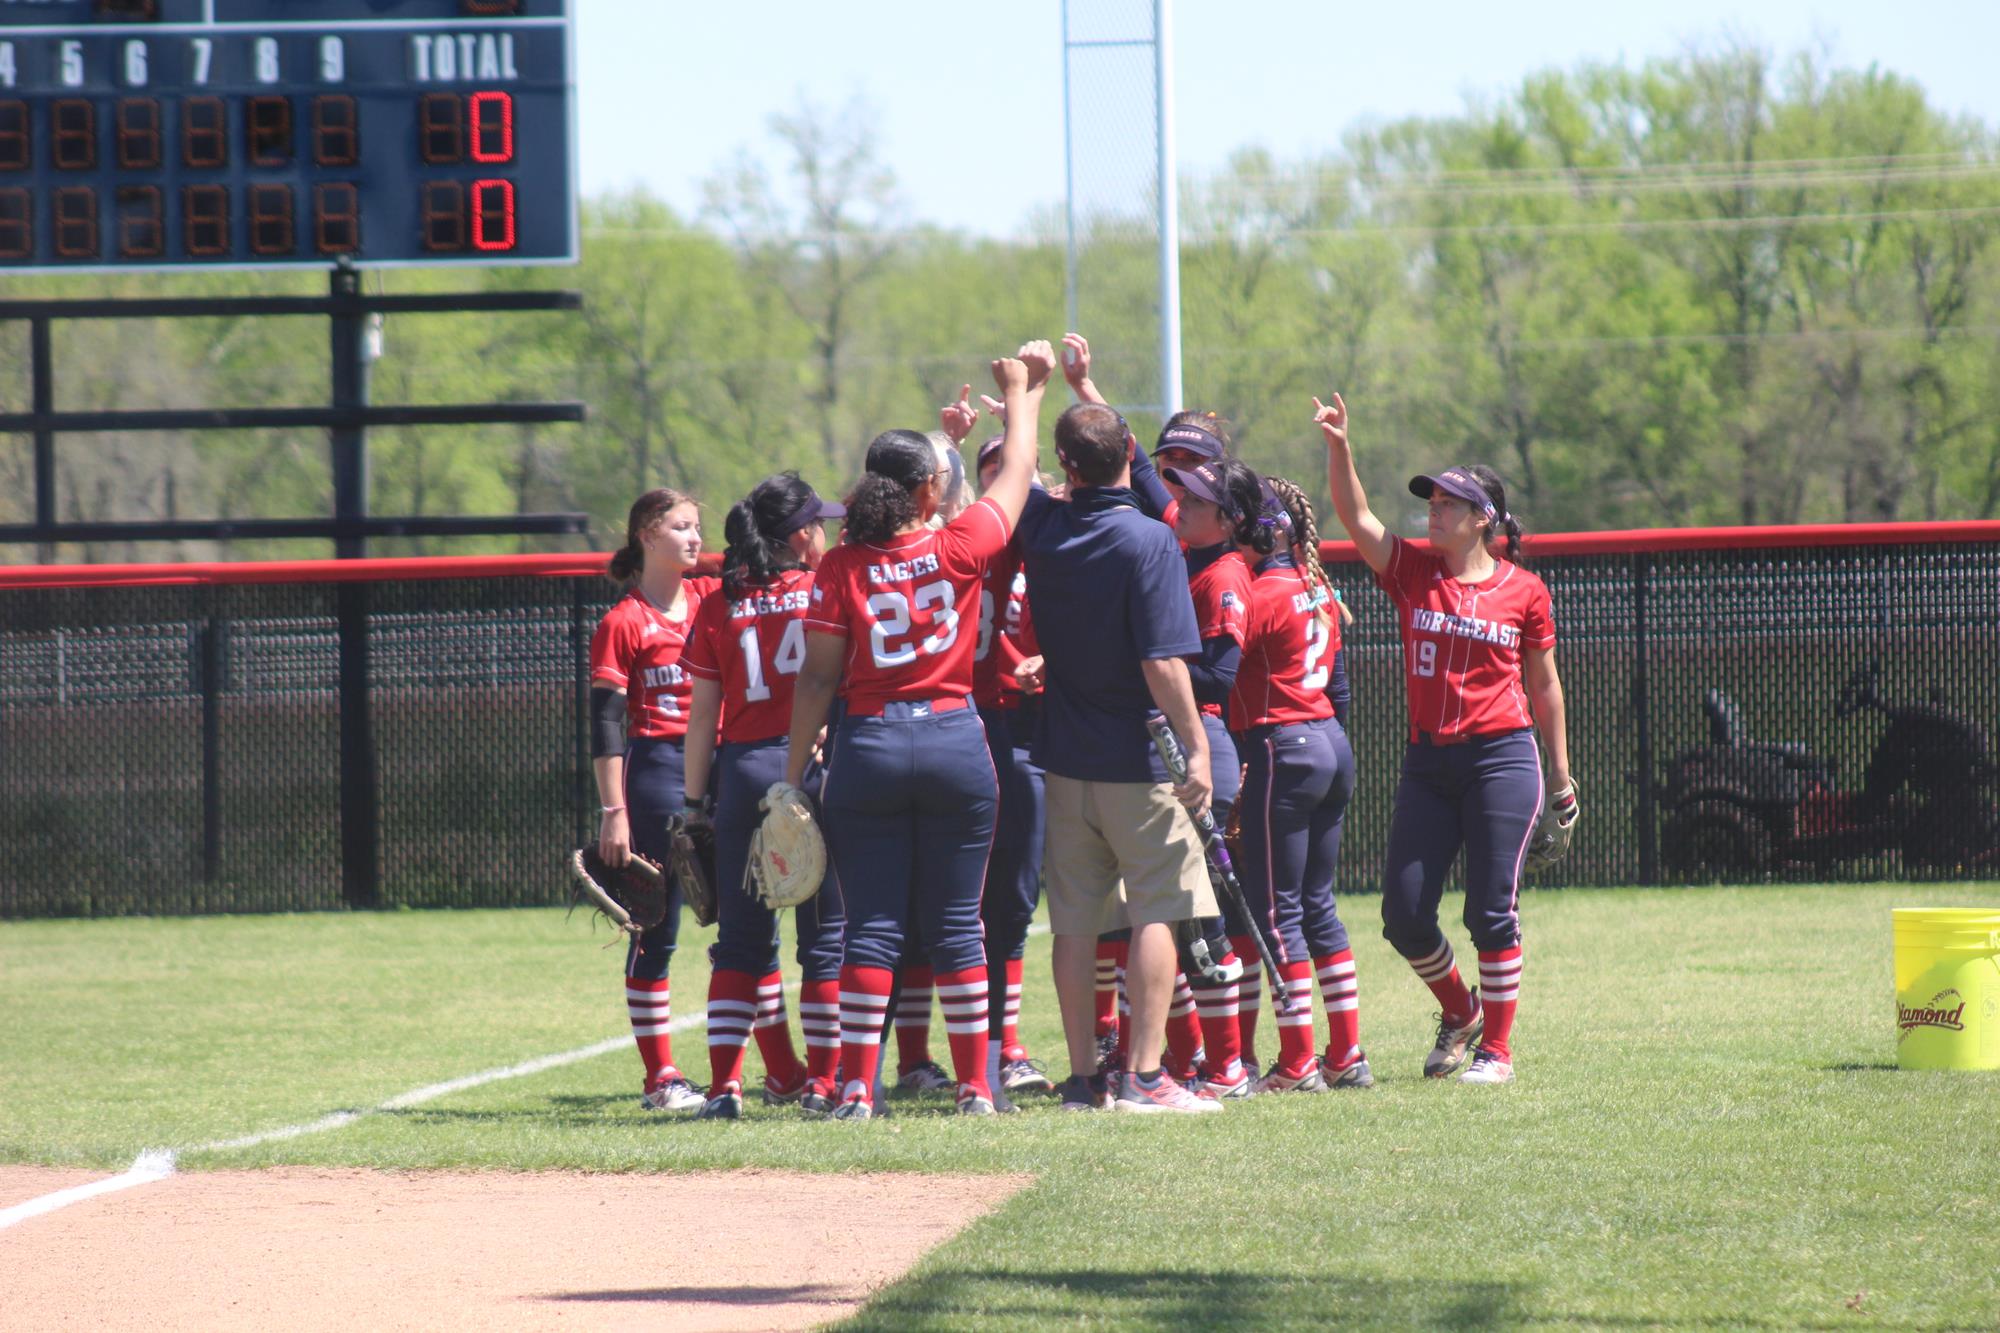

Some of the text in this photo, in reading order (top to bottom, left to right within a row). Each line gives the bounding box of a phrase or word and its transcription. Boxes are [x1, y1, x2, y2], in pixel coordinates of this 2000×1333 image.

[61, 40, 84, 86] 5
[125, 39, 148, 86] 6
[191, 38, 212, 85] 7
[255, 36, 279, 83] 8
[320, 35, 344, 82] 9
[413, 33, 518, 81] TOTAL
[469, 91, 513, 163] 0
[471, 179, 515, 250] 0
[866, 579, 960, 668] 23
[1302, 617, 1330, 689] 2
[1412, 639, 1437, 678] 19
[644, 663, 692, 688] NOR
[740, 618, 807, 702] 14
